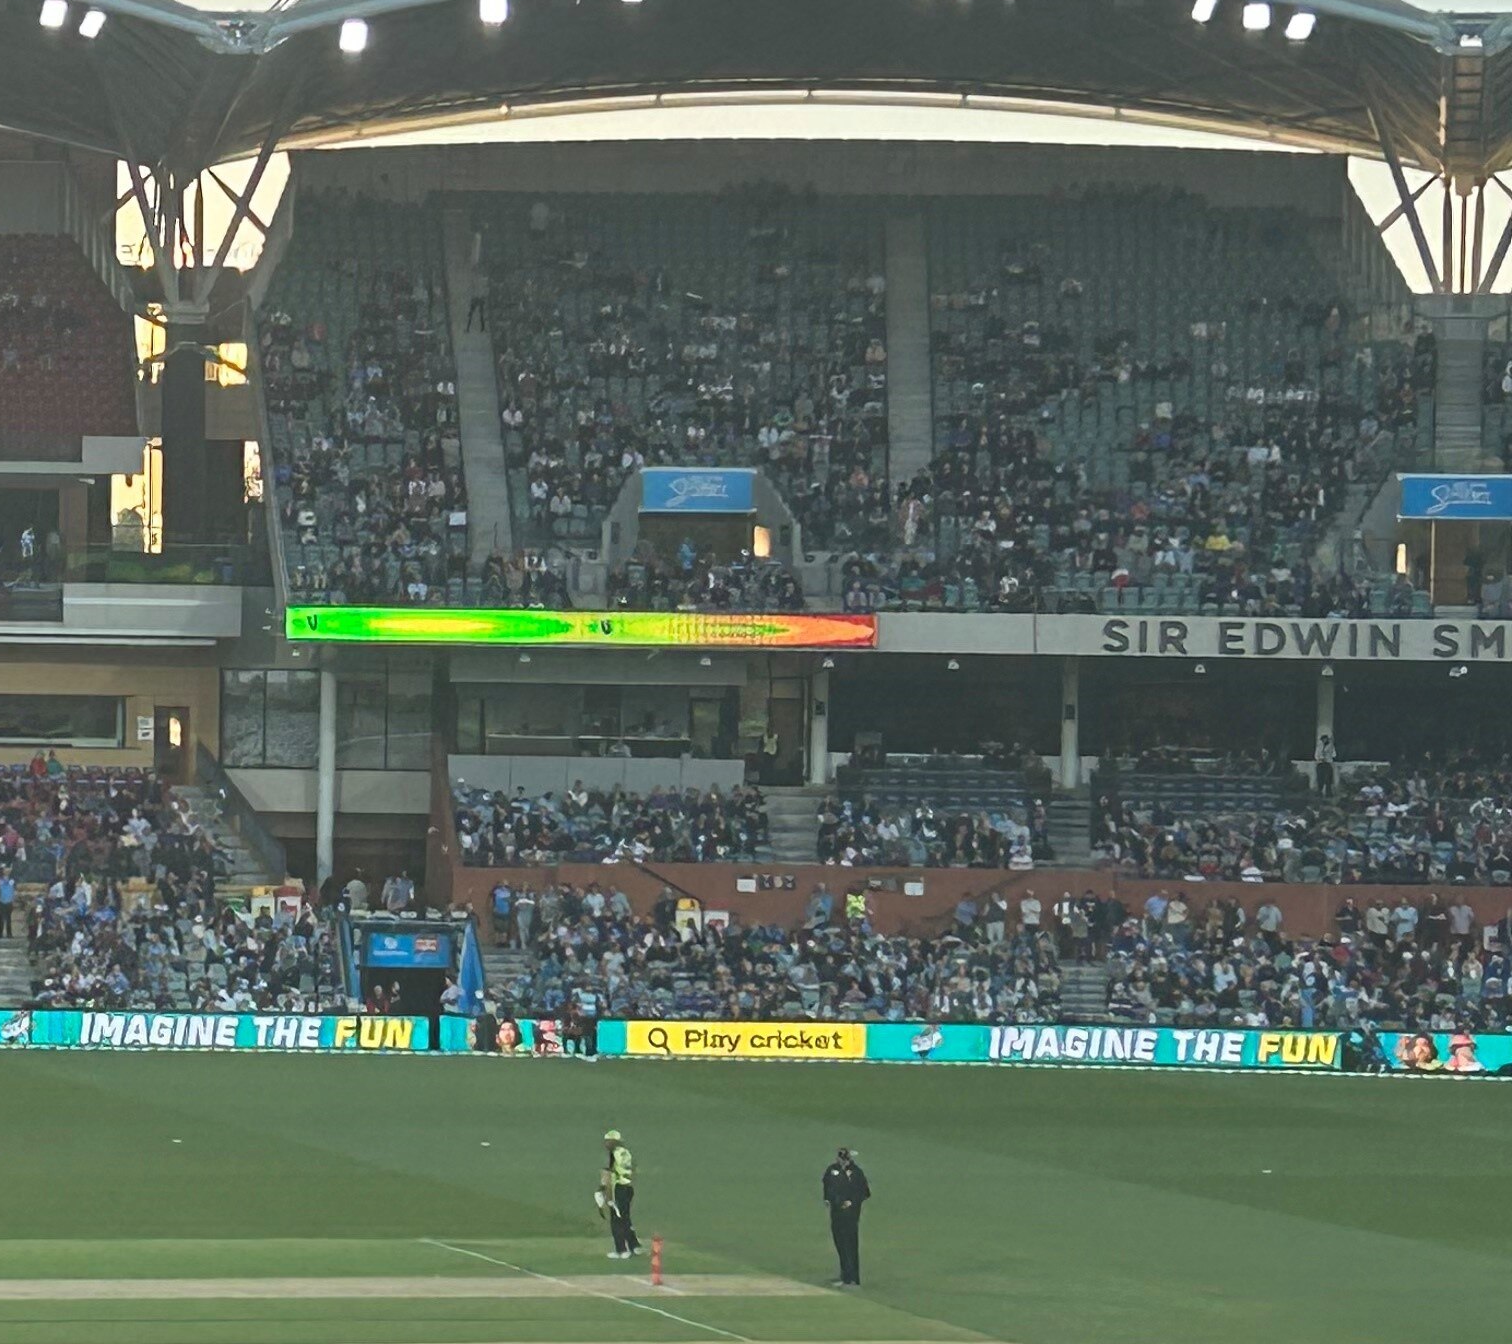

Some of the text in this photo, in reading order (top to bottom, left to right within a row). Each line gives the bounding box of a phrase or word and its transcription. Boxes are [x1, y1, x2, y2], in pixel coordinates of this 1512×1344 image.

[1102, 619, 1506, 659] SIR EDWIN SM
[80, 1012, 414, 1049] IMAGINE THE FUN
[684, 1029, 843, 1053] Play cricket
[989, 1026, 1341, 1065] IMAGINE THE FUN
